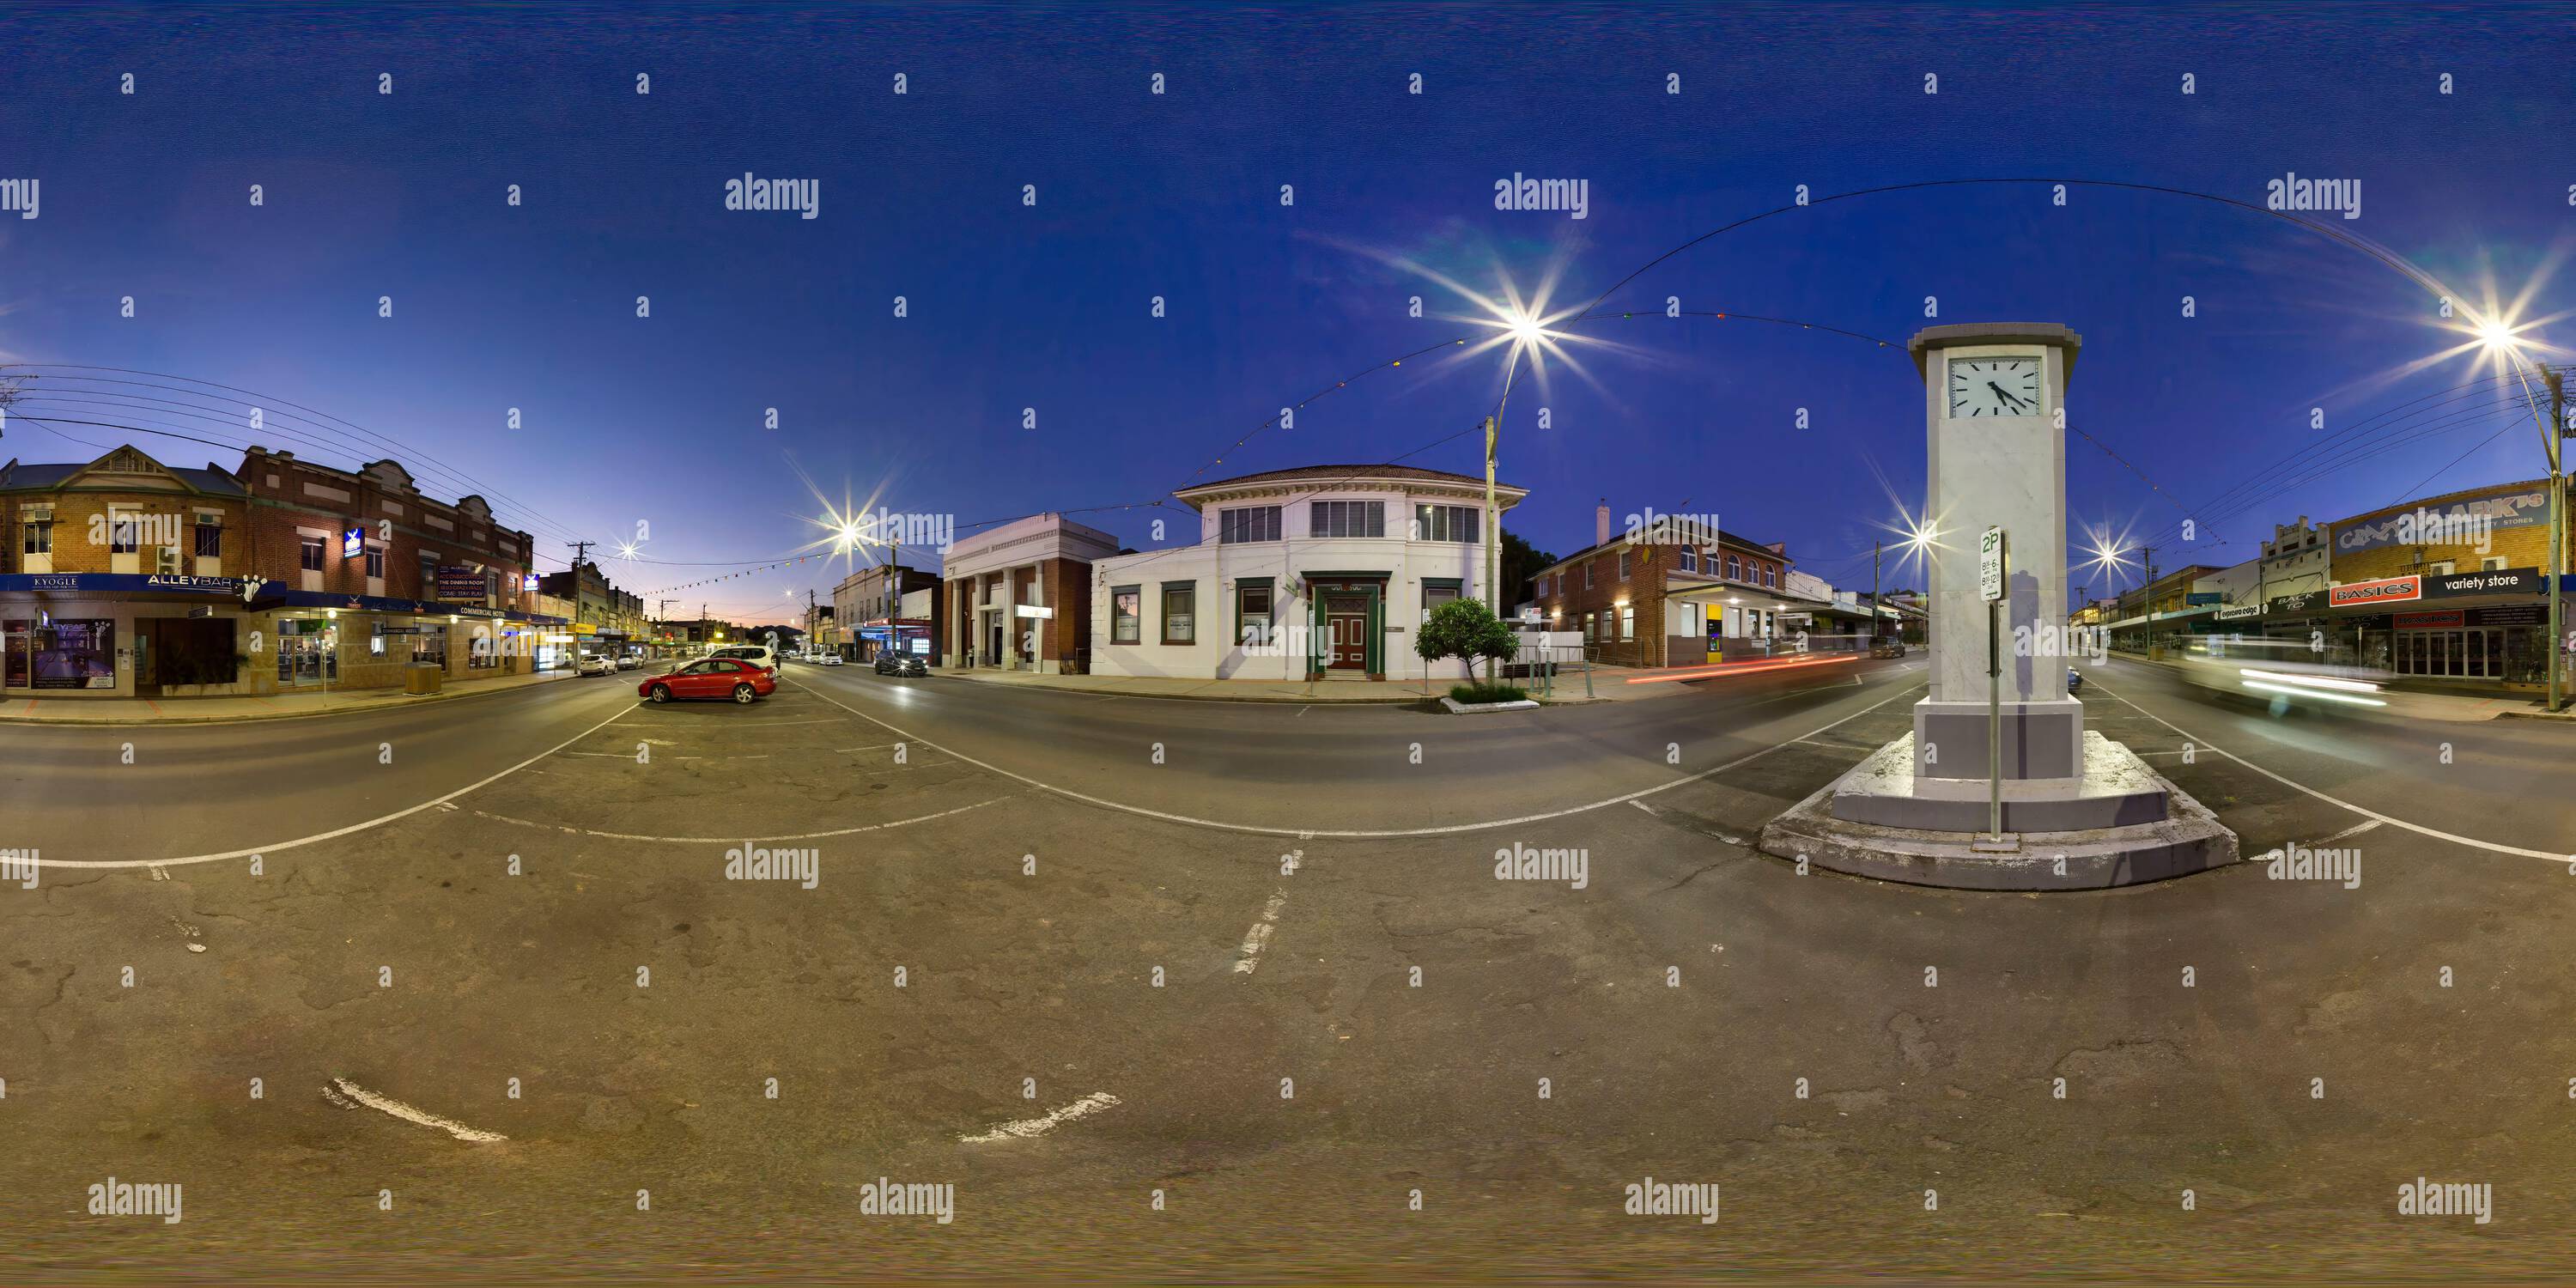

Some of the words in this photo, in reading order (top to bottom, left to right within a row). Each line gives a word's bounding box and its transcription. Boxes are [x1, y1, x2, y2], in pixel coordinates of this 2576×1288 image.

[2503, 517, 2533, 526] STORES
[1983, 532, 1999, 553] 2P
[2445, 577, 2485, 590] variety
[2488, 574, 2518, 586] store
[2336, 582, 2413, 600] BASICS
[2277, 592, 2314, 605] BACK
[460, 607, 491, 617] COMMERCIAL
[2242, 605, 2257, 616] edge
[2286, 601, 2305, 611] TO
